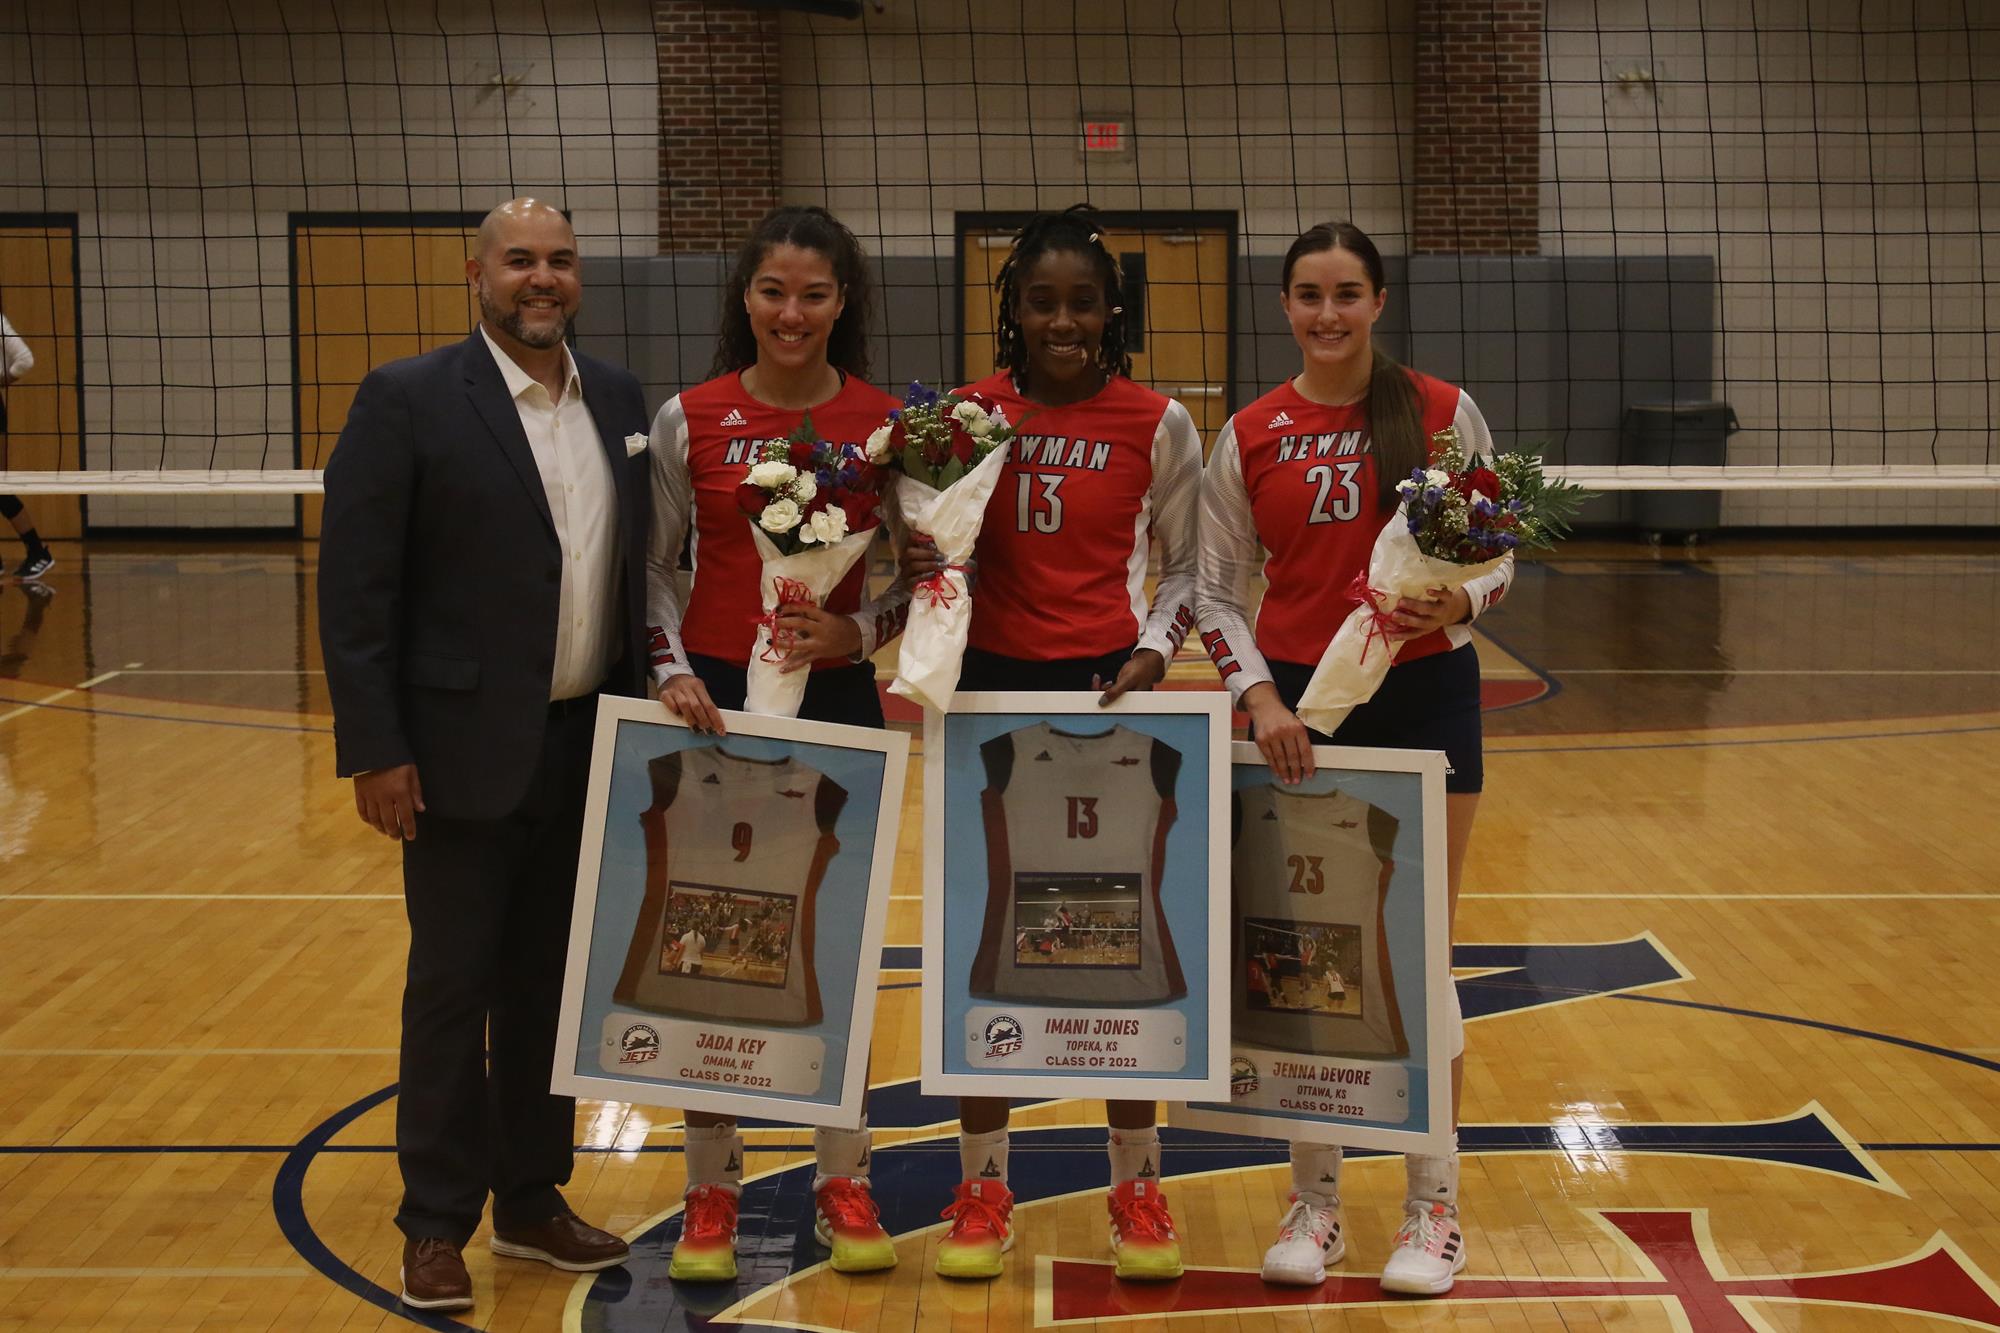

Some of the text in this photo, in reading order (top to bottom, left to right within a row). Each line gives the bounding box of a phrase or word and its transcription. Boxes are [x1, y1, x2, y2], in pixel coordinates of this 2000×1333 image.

[720, 418, 747, 427] adidas
[1267, 418, 1295, 430] adidas
[1277, 430, 1372, 463] NEWM
[1304, 461, 1361, 526] 23
[1016, 472, 1065, 534] 13
[1065, 796, 1099, 839] 13
[731, 821, 753, 863] 9
[1286, 854, 1325, 895] 23
[1045, 1018, 1139, 1036] IMANI JONES
[696, 1033, 767, 1055] JADA KEY
[985, 1040, 1023, 1056] JETS
[1066, 1040, 1118, 1053] TOPEKA, KS
[620, 1050, 659, 1062] JETS
[703, 1055, 754, 1070] OMAHA, NE
[1045, 1056, 1137, 1068] CLASS OF 2022
[680, 1068, 772, 1087] CLASS OF 2022
[1273, 1062, 1316, 1080] JENNA
[1320, 1066, 1371, 1085] DEVORE
[1297, 1085, 1347, 1099] OTTAWA, KS
[1279, 1098, 1365, 1116] CLASS OF 2022
